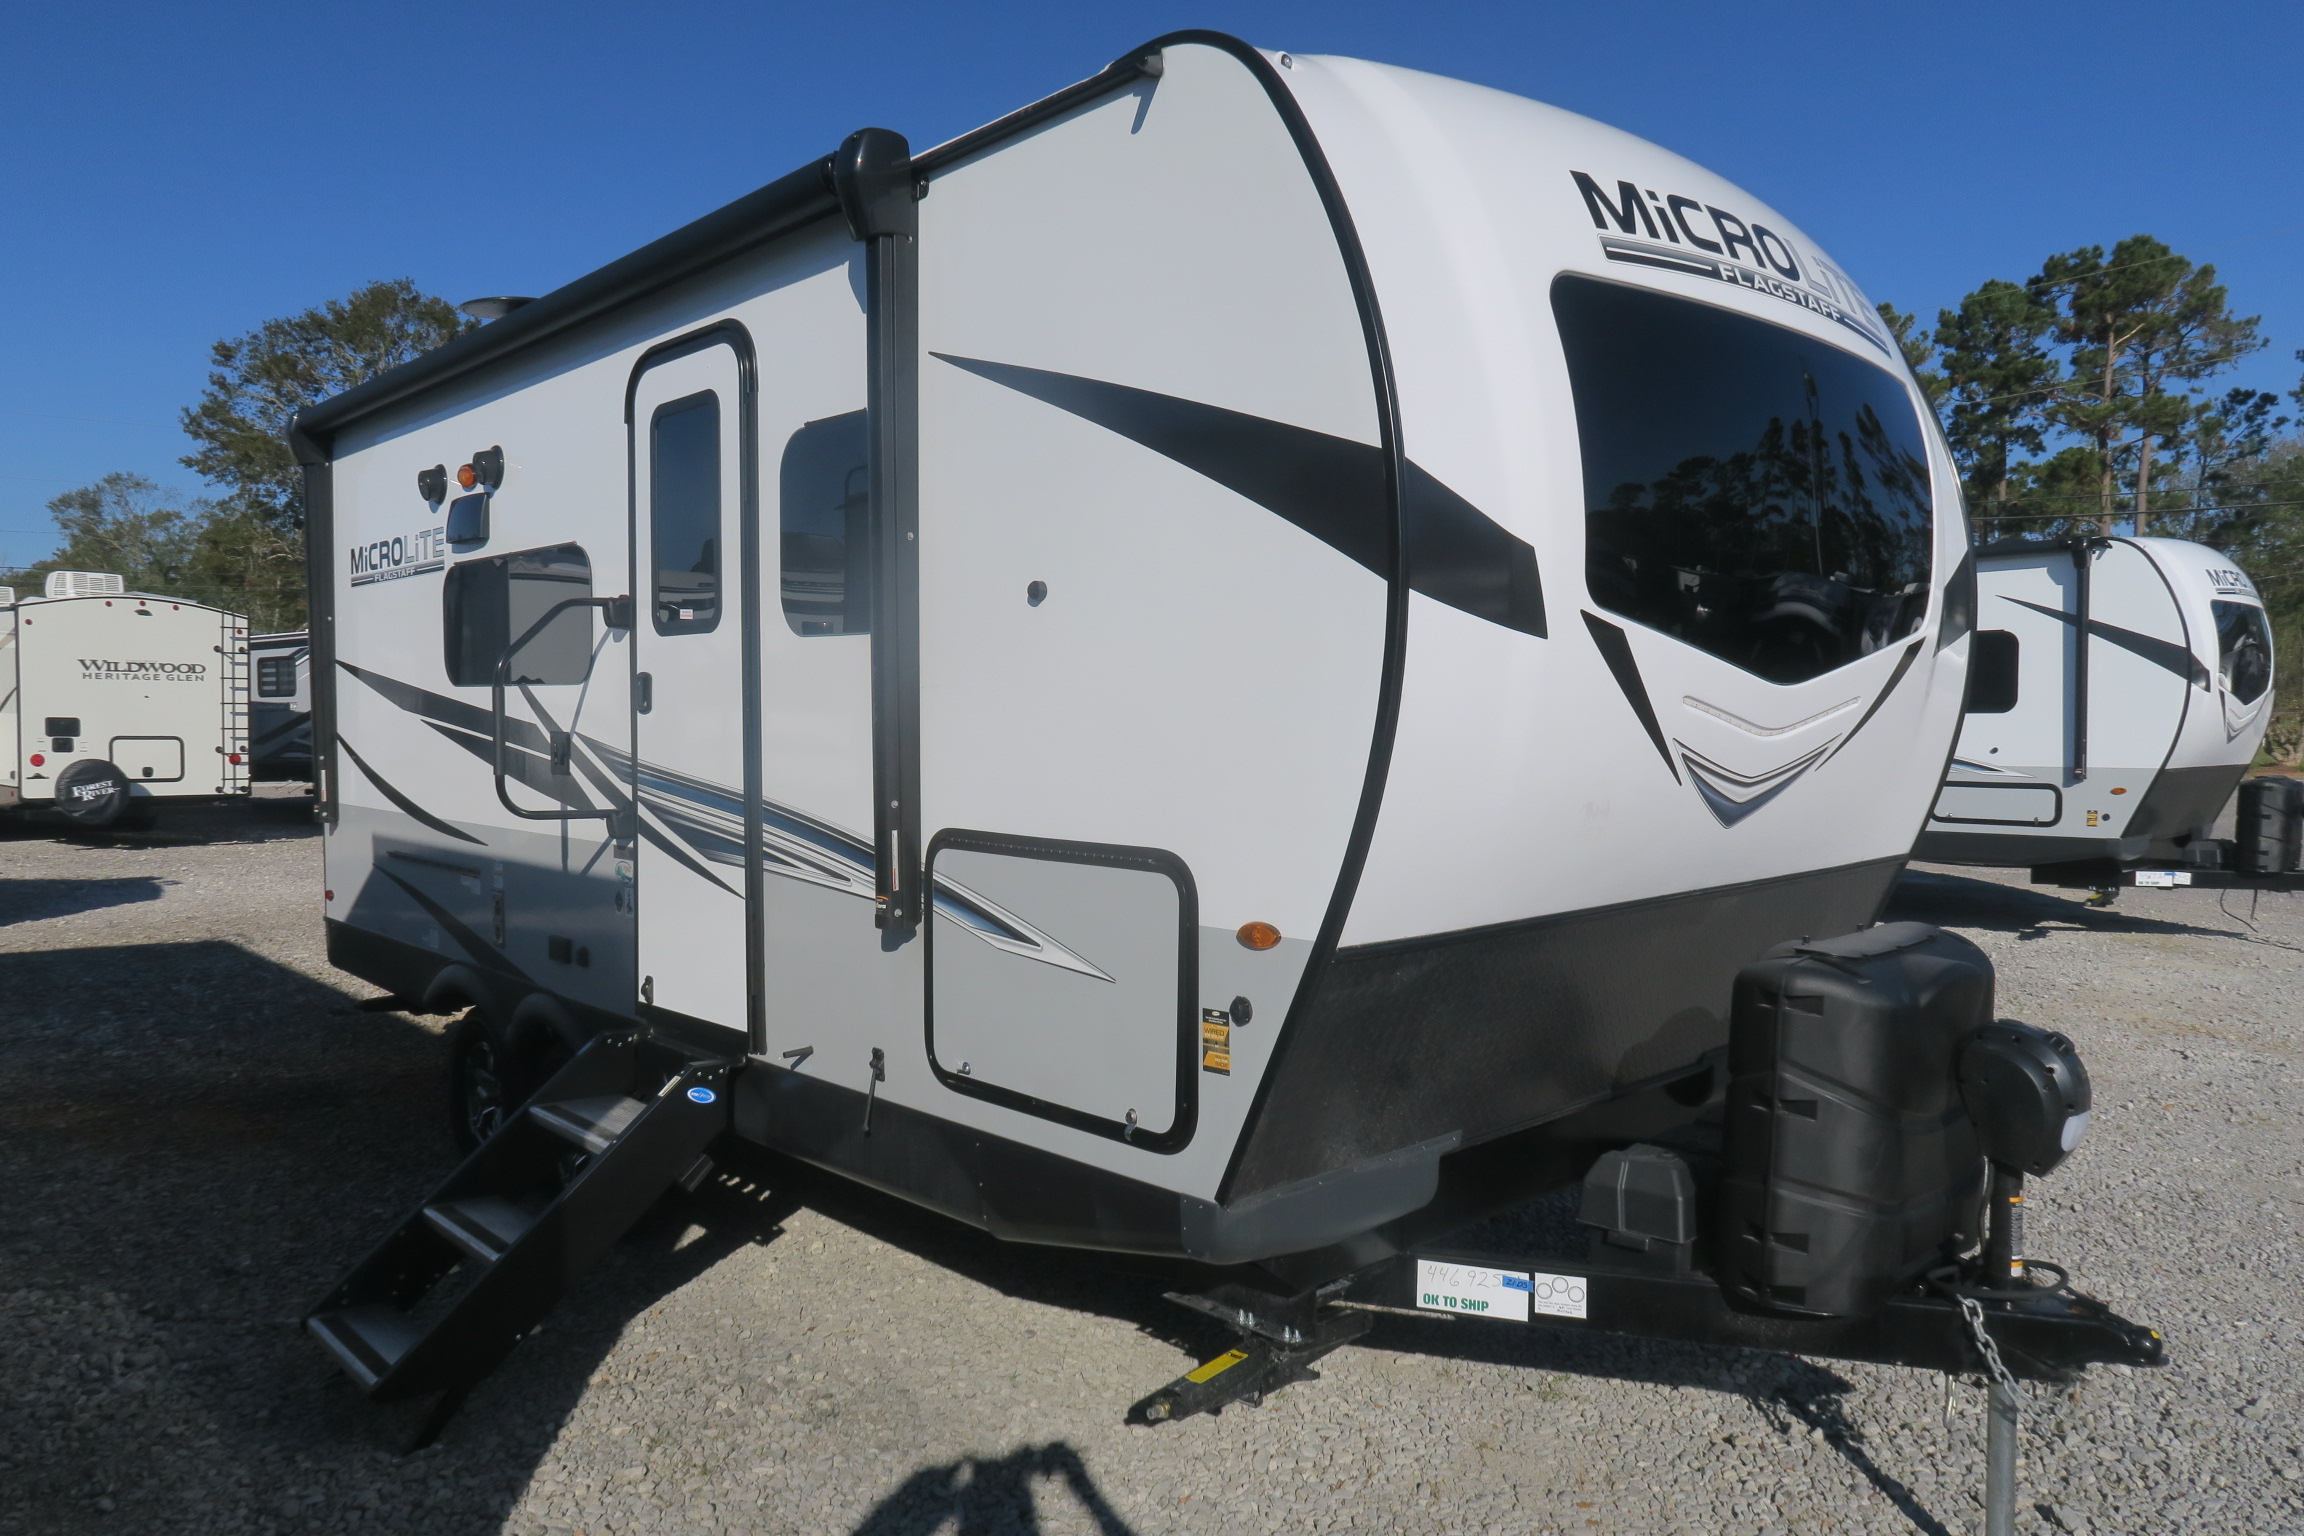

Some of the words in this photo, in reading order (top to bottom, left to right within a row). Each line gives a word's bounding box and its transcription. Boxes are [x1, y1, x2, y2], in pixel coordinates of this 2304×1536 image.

[1718, 262, 1841, 321] FLAGSTAFF
[374, 566, 416, 582] FLAGSTAFF
[77, 659, 206, 674] WILDWOOD
[82, 672, 161, 681] HERITAGE
[165, 673, 205, 682] GLEN
[71, 780, 114, 798] FOREST
[82, 787, 116, 801] RIVER
[1422, 1293, 1439, 1306] OK
[1442, 1295, 1458, 1308] TO
[1461, 1298, 1489, 1312] SHIP
